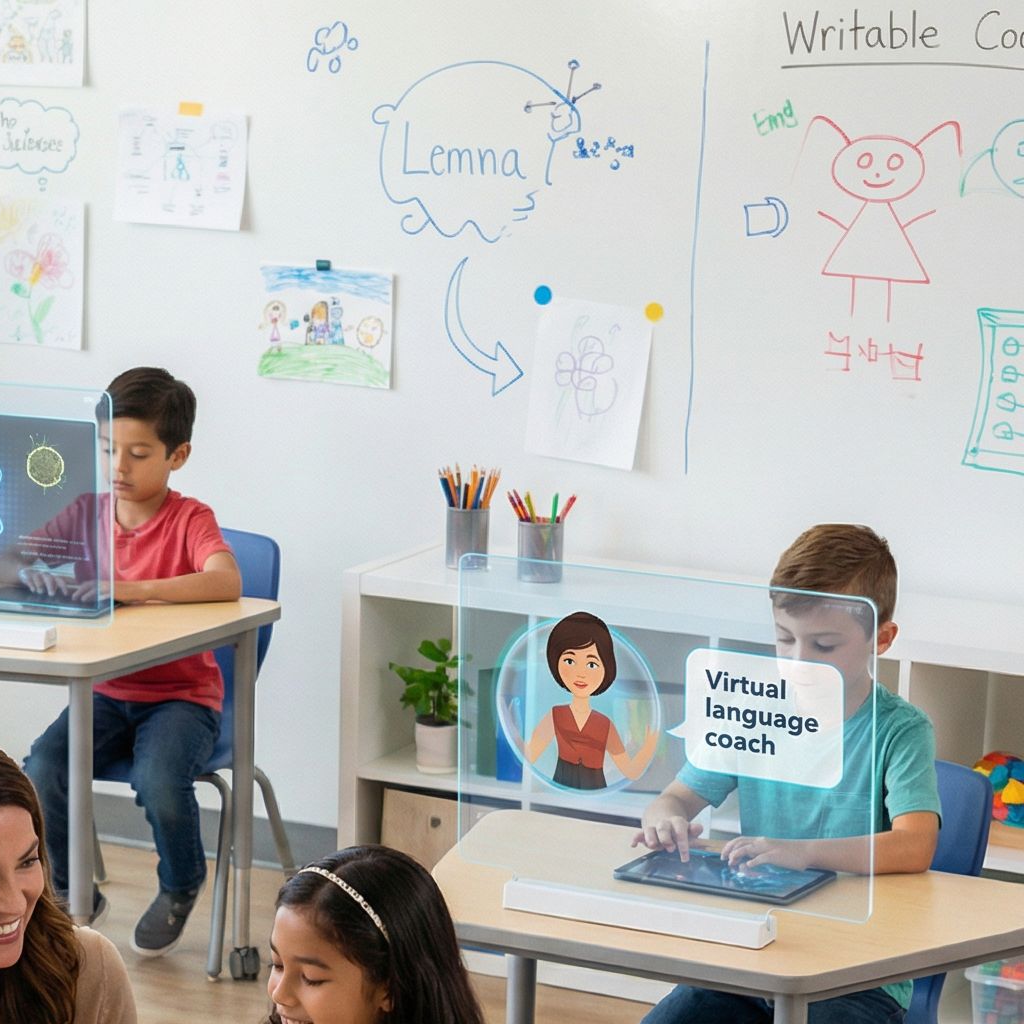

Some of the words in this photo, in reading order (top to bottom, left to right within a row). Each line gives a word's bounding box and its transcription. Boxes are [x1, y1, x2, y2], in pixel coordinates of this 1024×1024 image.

[783, 8, 941, 55] Writable
[974, 10, 1024, 51] Co
[401, 120, 527, 180] Lemna
[705, 669, 786, 700] Virtual
[705, 697, 820, 736] language
[705, 731, 775, 755] coach
